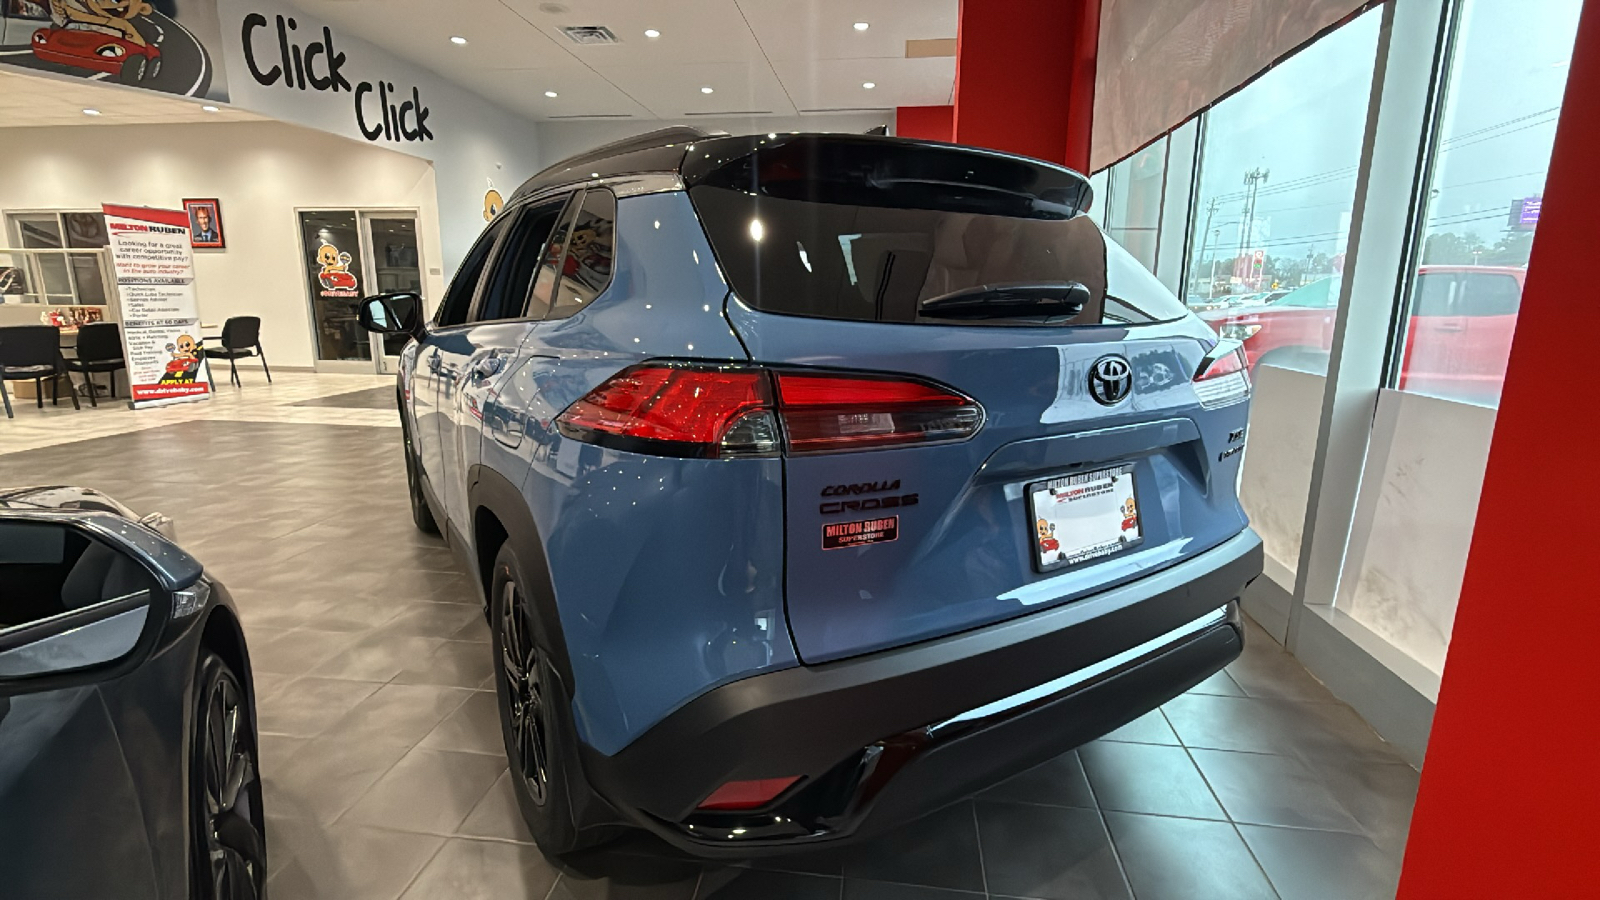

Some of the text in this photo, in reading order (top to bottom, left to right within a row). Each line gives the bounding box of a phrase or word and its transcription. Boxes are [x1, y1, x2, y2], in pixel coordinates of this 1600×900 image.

[241, 12, 433, 142] Click Click
[109, 223, 186, 235] MILTON RUBEN
[118, 240, 147, 248] Looking
[820, 479, 901, 497] COROLLA
[1085, 482, 1114, 494] RUBEN
[820, 493, 919, 514] CROSS
[826, 518, 895, 537] MILTON RUBEN
[838, 531, 884, 544] SUPERSTORE
